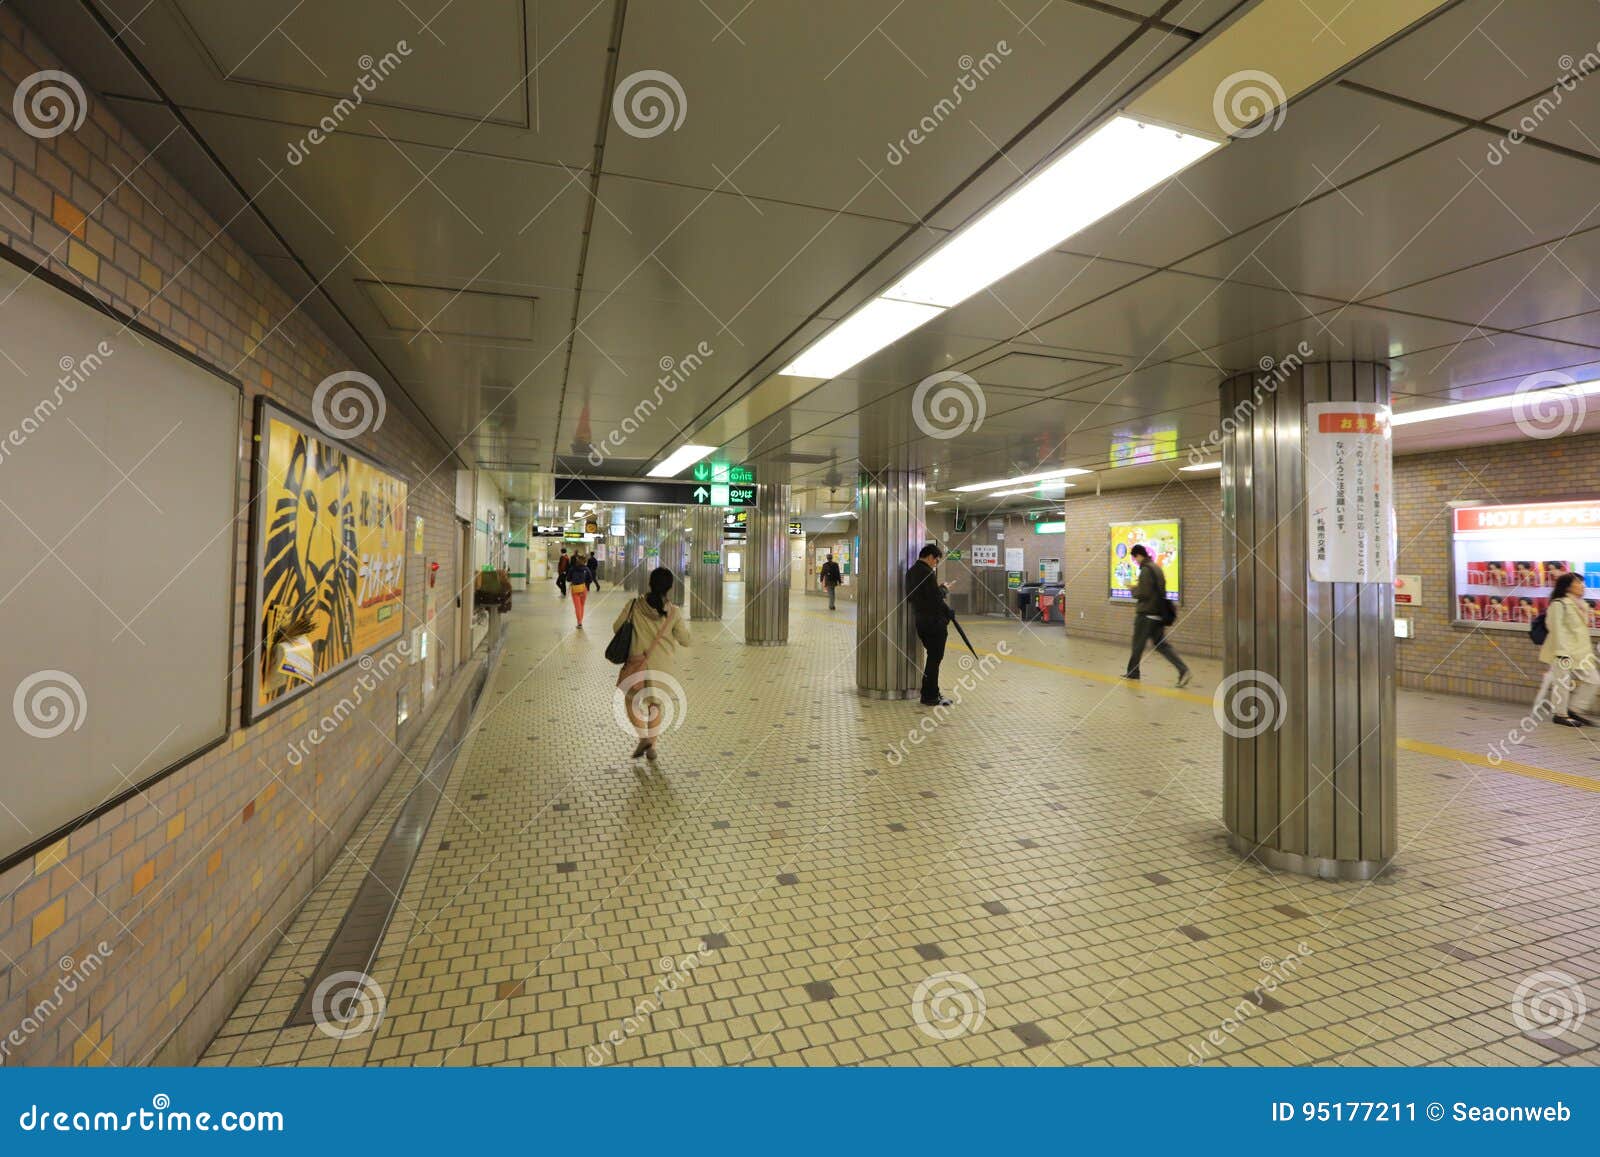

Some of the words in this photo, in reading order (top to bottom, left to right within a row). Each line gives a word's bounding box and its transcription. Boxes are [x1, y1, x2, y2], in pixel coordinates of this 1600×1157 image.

[730, 489, 753, 498] のりば
[1477, 511, 1519, 527] HOT
